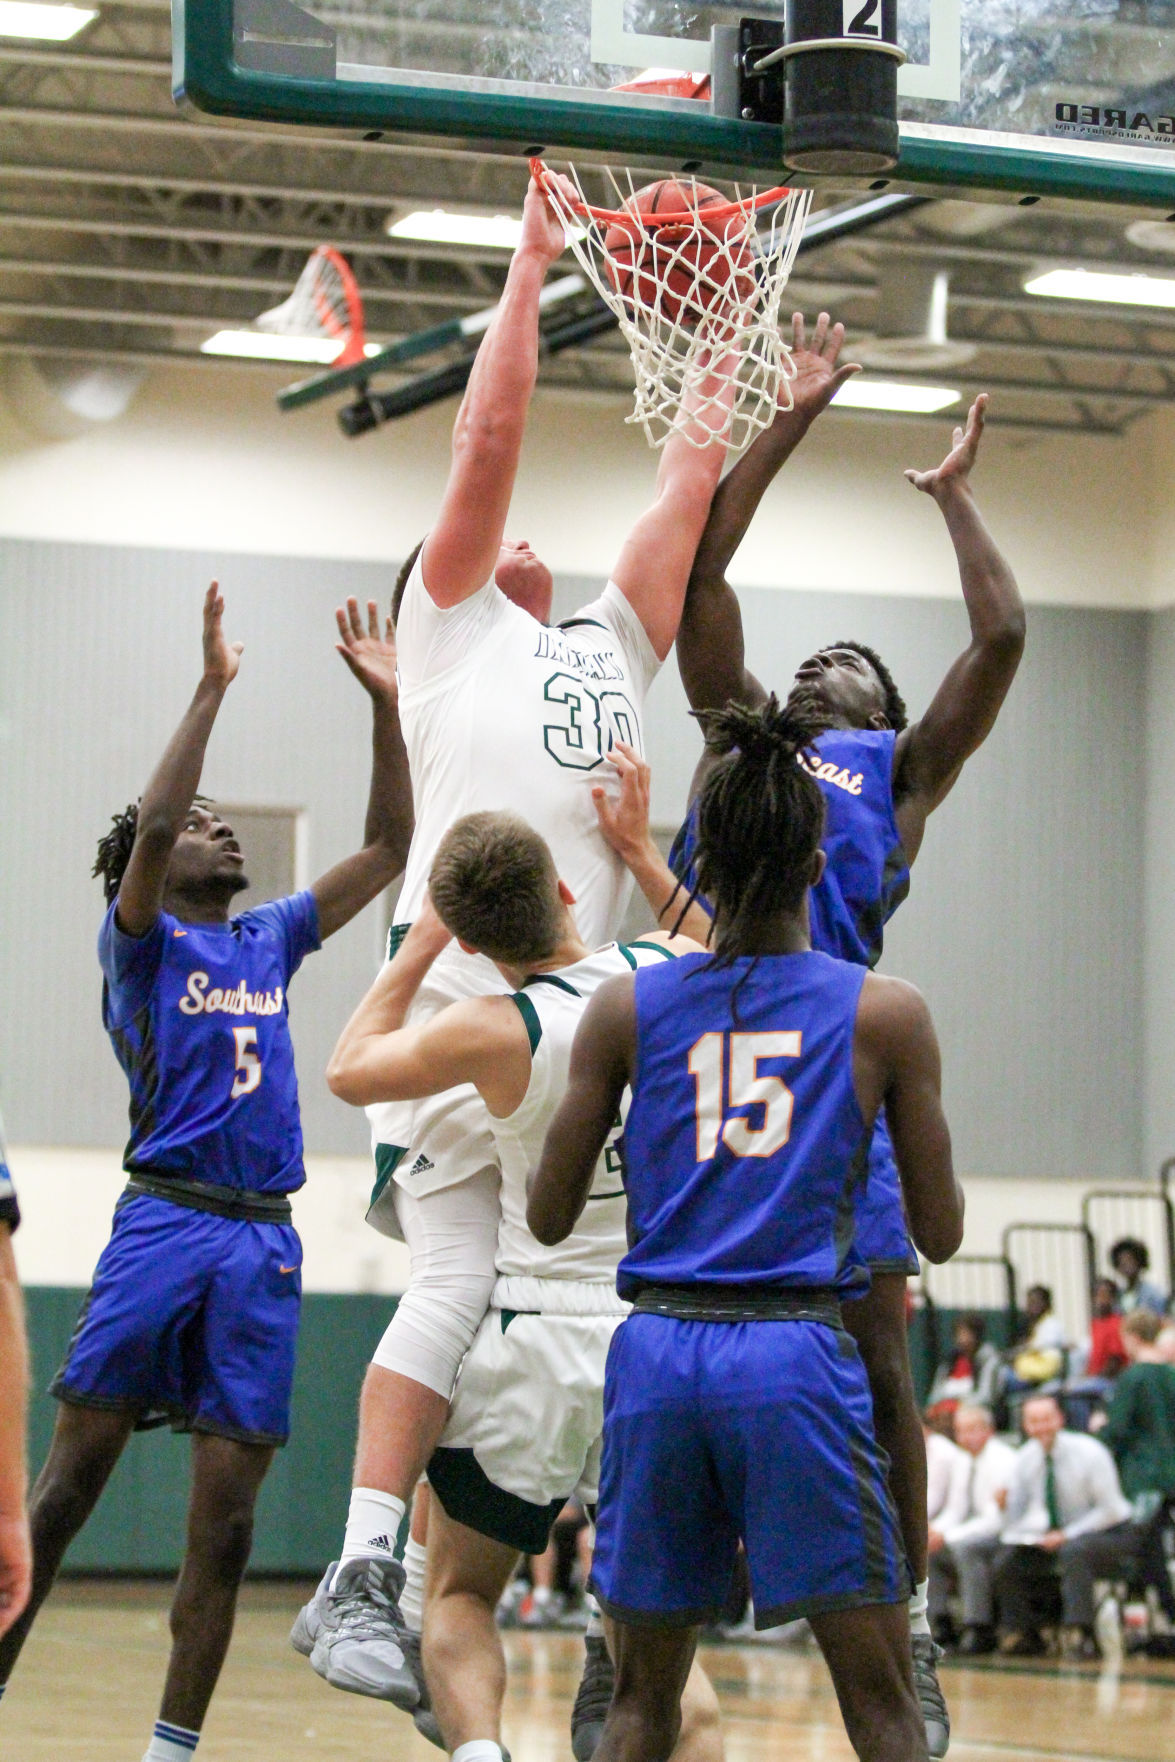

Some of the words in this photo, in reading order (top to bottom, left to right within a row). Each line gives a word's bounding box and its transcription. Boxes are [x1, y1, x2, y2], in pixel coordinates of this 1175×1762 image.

[848, 0, 879, 36] 2
[544, 672, 642, 771] 30
[796, 752, 864, 795] east
[231, 1026, 262, 1099] 5
[688, 1031, 802, 1162] 15
[410, 1162, 435, 1176] adidas
[368, 1540, 392, 1552] adidas
